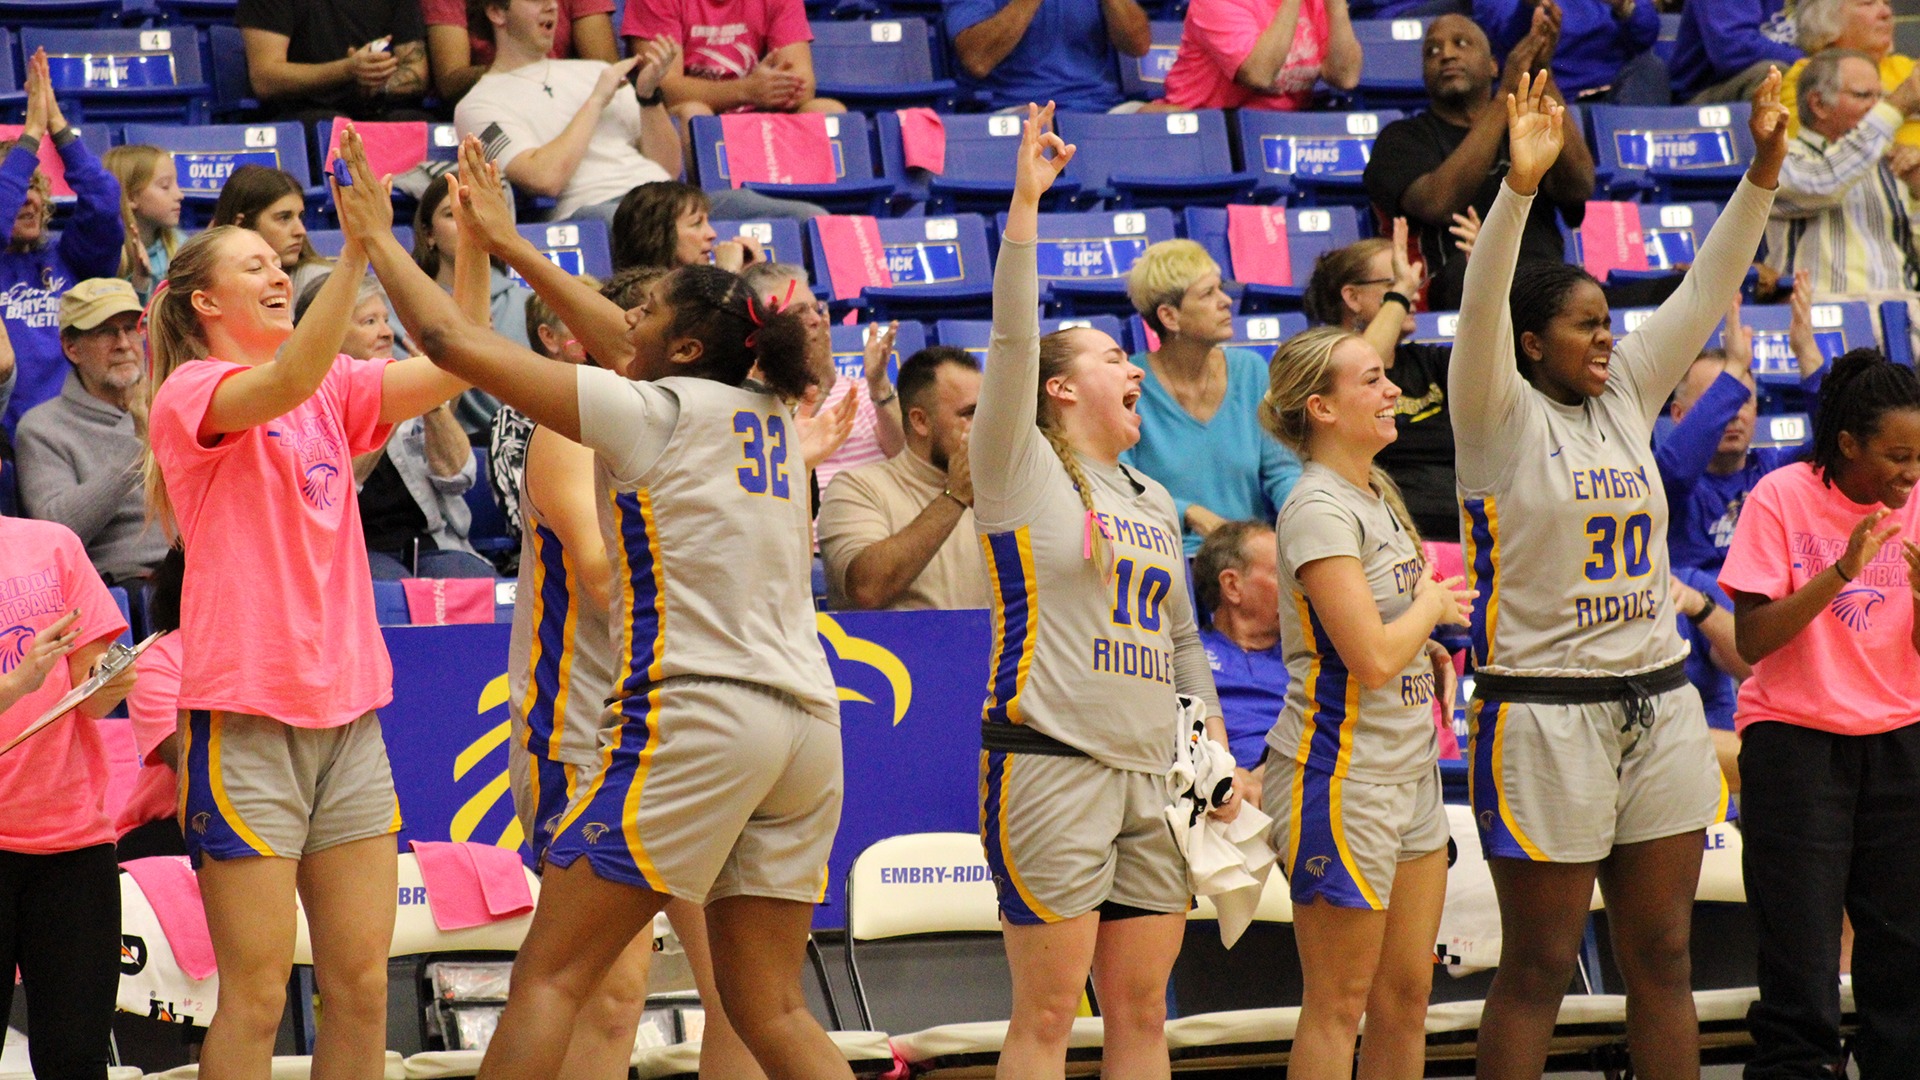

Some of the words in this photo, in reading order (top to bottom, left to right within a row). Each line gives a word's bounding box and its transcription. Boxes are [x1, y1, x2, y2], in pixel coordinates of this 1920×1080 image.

[150, 33, 161, 48] 4
[256, 130, 266, 145] 4
[1297, 147, 1340, 163] PARKS
[1648, 141, 1698, 157] ETERS
[188, 162, 236, 179] OXLEY
[1126, 216, 1134, 233] 8
[1310, 214, 1319, 230] 9
[558, 228, 568, 245] 5
[888, 255, 915, 272] ICK
[1062, 250, 1104, 267] SLICK
[1259, 321, 1268, 338] 8
[1779, 421, 1796, 438] 10
[731, 407, 791, 502] 32
[1572, 464, 1652, 501] EMBRY
[1095, 510, 1178, 562] EMBRY
[1582, 511, 1655, 583] 30
[1393, 557, 1423, 595] EMB
[508, 583, 517, 602] 3
[1110, 555, 1173, 636] 10
[1574, 589, 1657, 628] RIDDLE
[1092, 637, 1173, 686] RIDDLE
[1703, 833, 1726, 850] LE
[398, 886, 427, 906] BR
